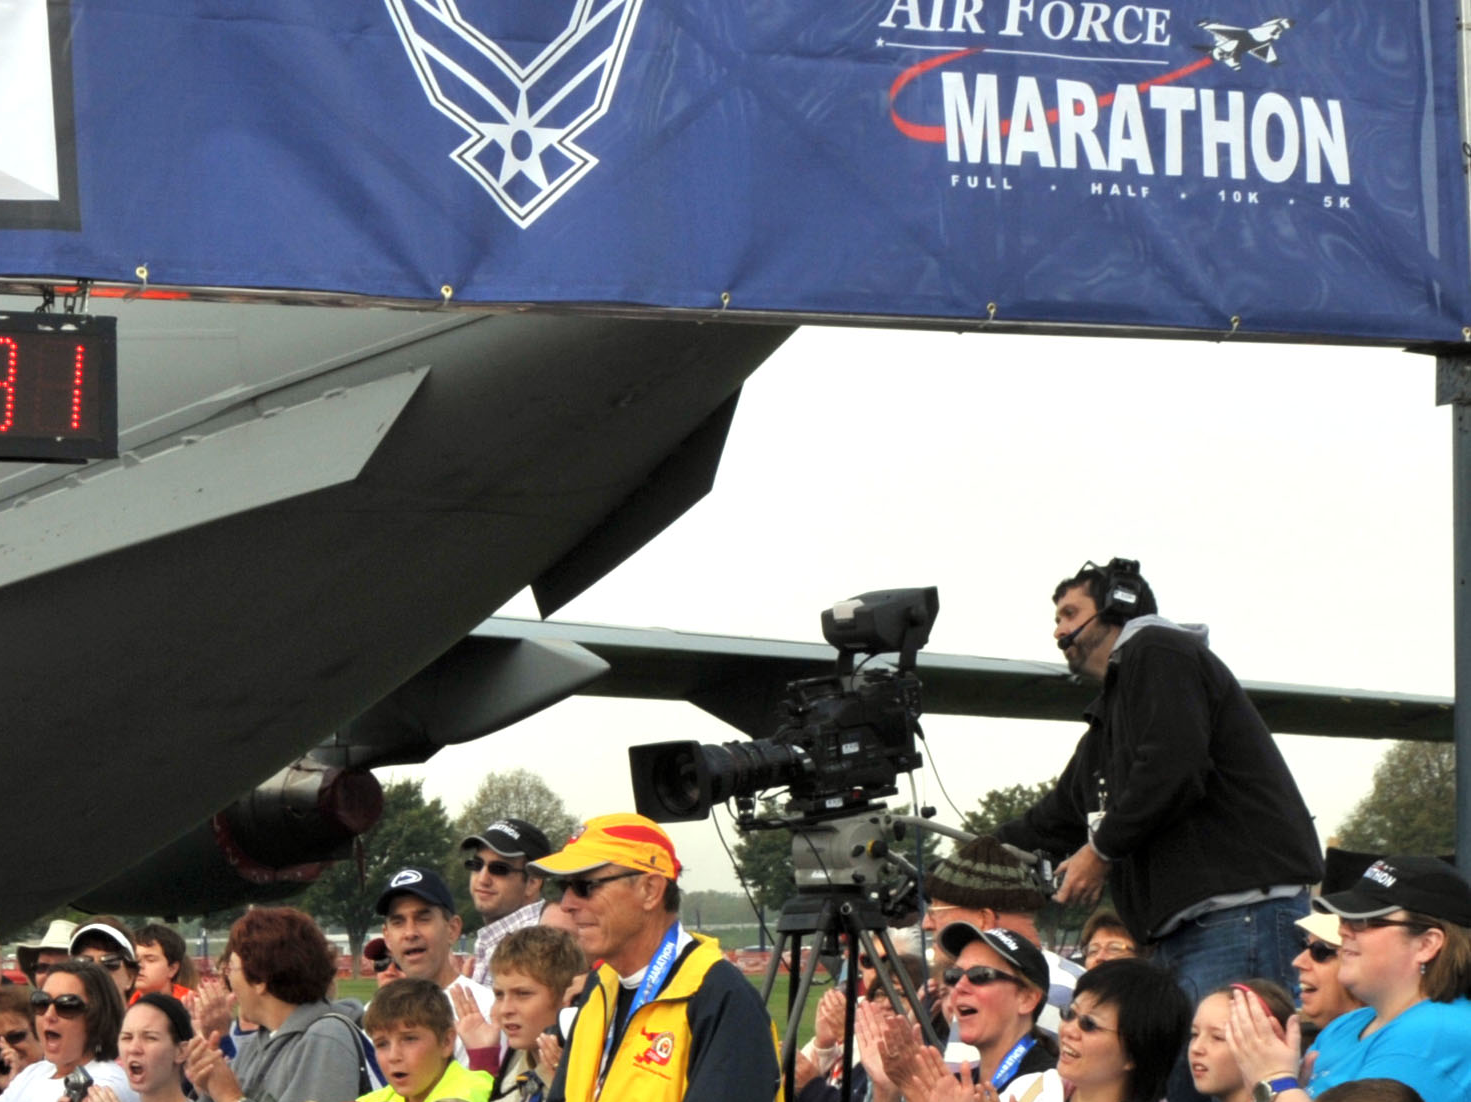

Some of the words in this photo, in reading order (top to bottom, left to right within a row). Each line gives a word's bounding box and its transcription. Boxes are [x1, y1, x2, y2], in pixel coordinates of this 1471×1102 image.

[880, 0, 984, 35] AIR
[998, 0, 1171, 47] FORCE
[941, 71, 1351, 185] MARATHON
[951, 174, 1013, 190] FULL
[1090, 182, 1150, 199] HALF
[1218, 189, 1260, 204] 10K
[1323, 195, 1351, 208] 5K
